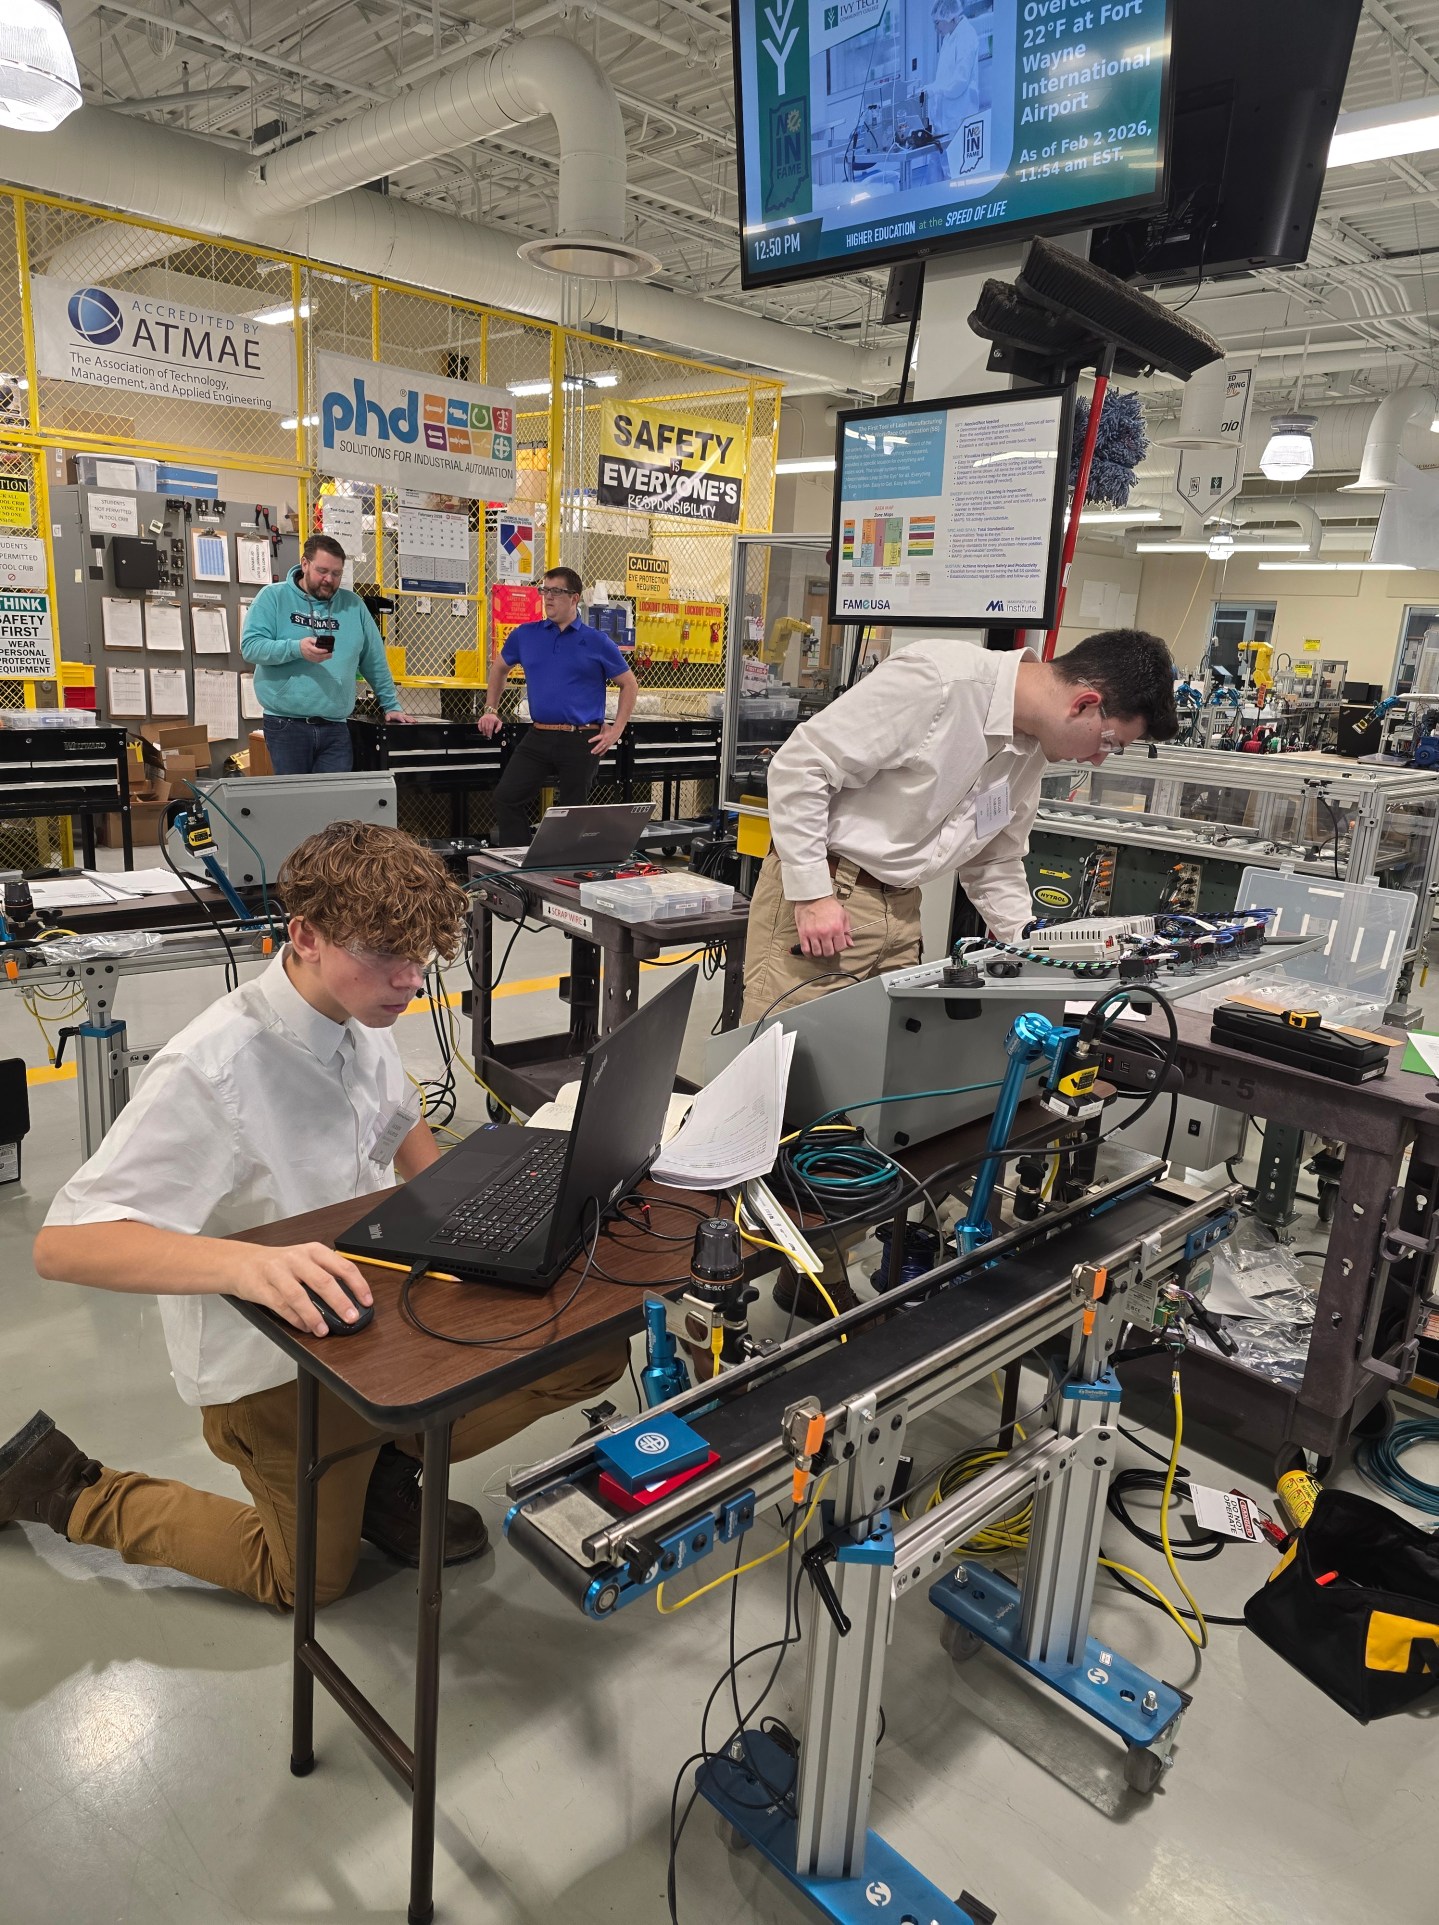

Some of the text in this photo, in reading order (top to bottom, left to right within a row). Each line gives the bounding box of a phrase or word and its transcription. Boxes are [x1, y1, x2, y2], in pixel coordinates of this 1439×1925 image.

[840, 1, 855, 16] IVY
[1023, 0, 1143, 48] 22°F at Fort
[1022, 42, 1087, 74] Wayne
[1021, 47, 1151, 100] International
[1020, 91, 1088, 125] Airport
[966, 136, 981, 153] IN
[1019, 120, 1152, 164] As of Feb 2 2026,
[1019, 146, 1124, 183] 11:54 am EST.
[846, 200, 1008, 248] HIGHER EDUCATION at the SPEED OF LIFE
[754, 232, 800, 261] 12:50 PM
[131, 300, 259, 336] ACCREDITED BY
[132, 318, 262, 371] ATMAE
[69, 351, 229, 391] The Association of Technology,
[71, 366, 272, 410] Management, and Applied Engineering
[322, 378, 419, 450] phd
[613, 414, 734, 465] SAFETY
[339, 440, 513, 480] SOLUTIONS FOR INDUSTRIAL AUTOMATION
[672, 461, 680, 472] IS
[603, 462, 738, 505] EVERYONE'S
[628, 493, 717, 519] RESPONSIBILITY
[18, 564, 34, 572] CRIB
[628, 573, 669, 585] EYE PROTECTION
[629, 557, 668, 573] CAUTION
[636, 582, 661, 592] REQUIRED
[0, 614, 45, 626] AFETY
[639, 601, 679, 614] LOCKOUT CENTER
[684, 604, 722, 617] LOCKOUT CENTER
[1006, 604, 1037, 612] Institute
[1, 626, 39, 637] FIRST
[8, 640, 36, 648] WEAR
[1040, 892, 1066, 903] HYTROL
[551, 907, 583, 926] SCRAP WIRE
[1223, 1495, 1237, 1534] OPERATE
[1231, 1500, 1243, 1533] DO NOT
